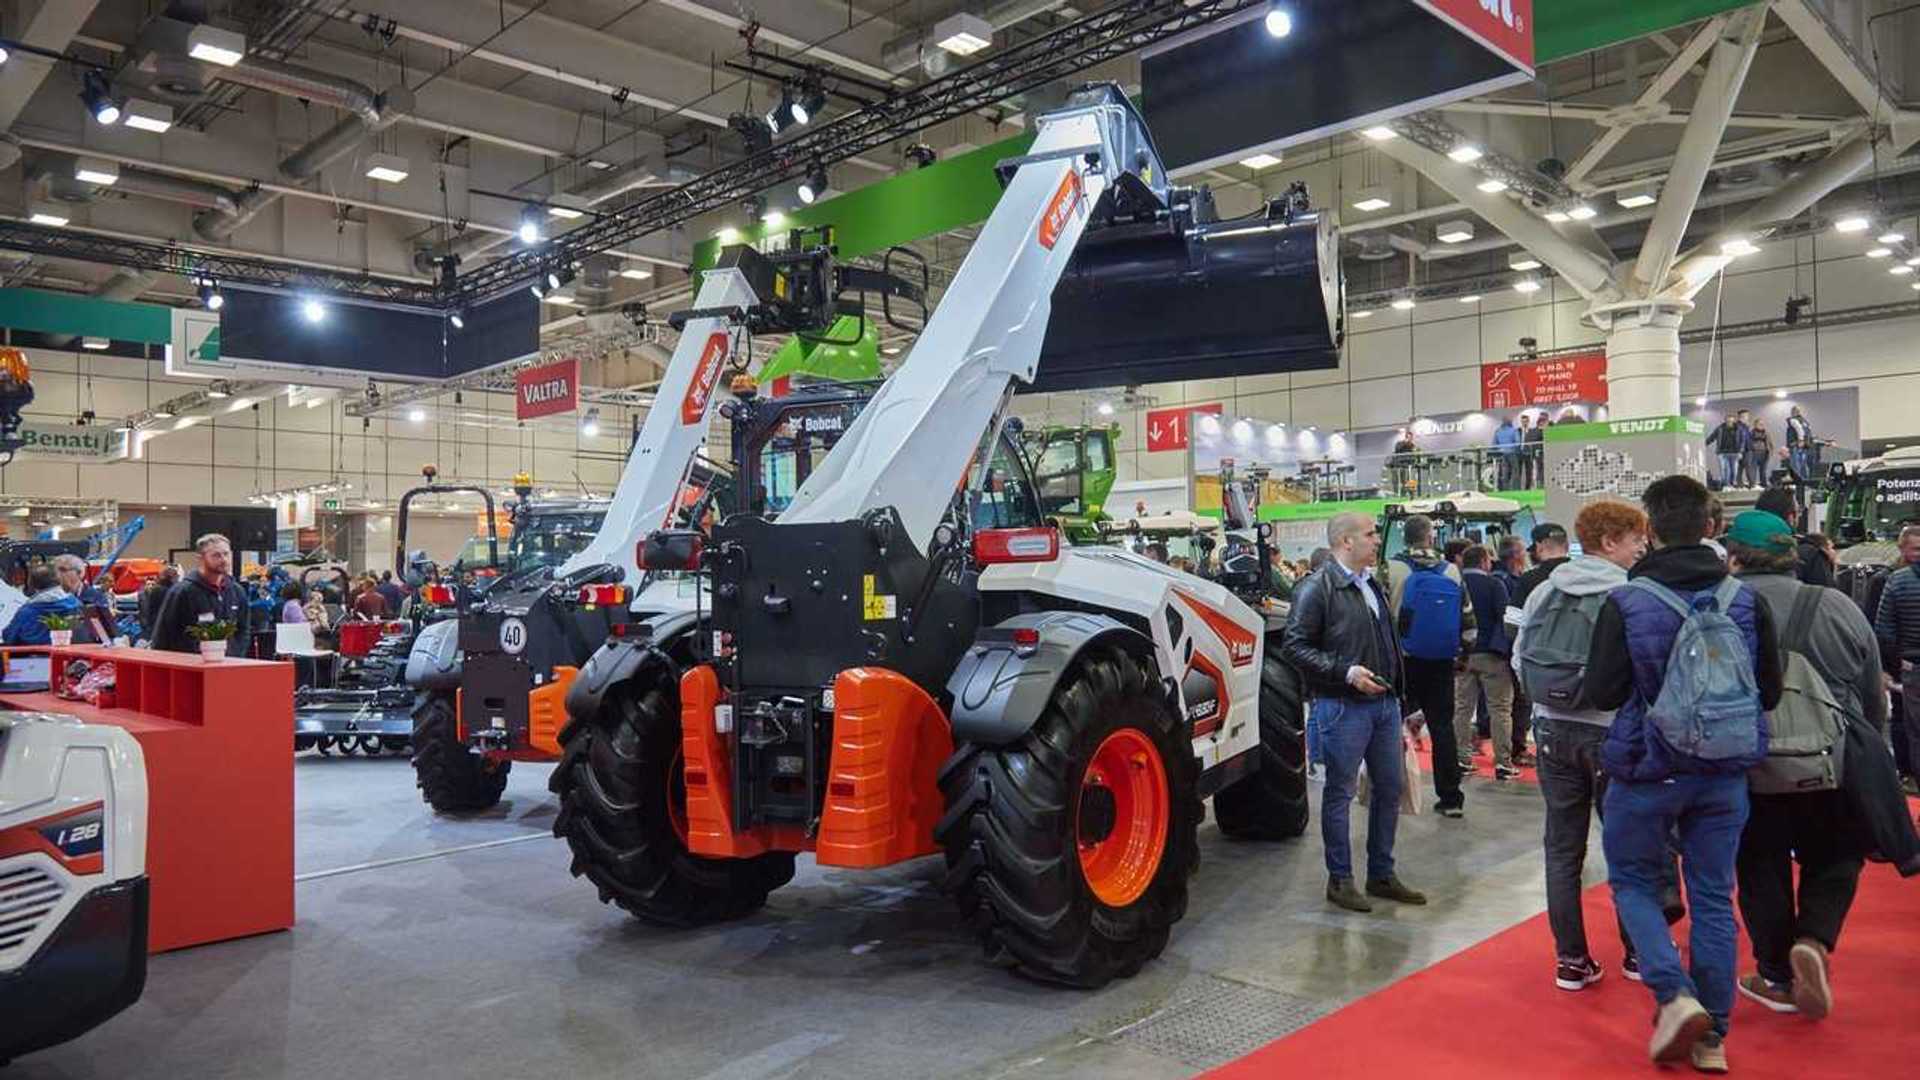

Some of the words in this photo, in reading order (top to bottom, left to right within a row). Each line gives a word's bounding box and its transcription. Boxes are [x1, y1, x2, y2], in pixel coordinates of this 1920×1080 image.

[523, 379, 569, 404] VALTRA
[805, 416, 843, 432] Bobcat
[22, 430, 99, 449] Benati
[504, 625, 521, 646] 40
